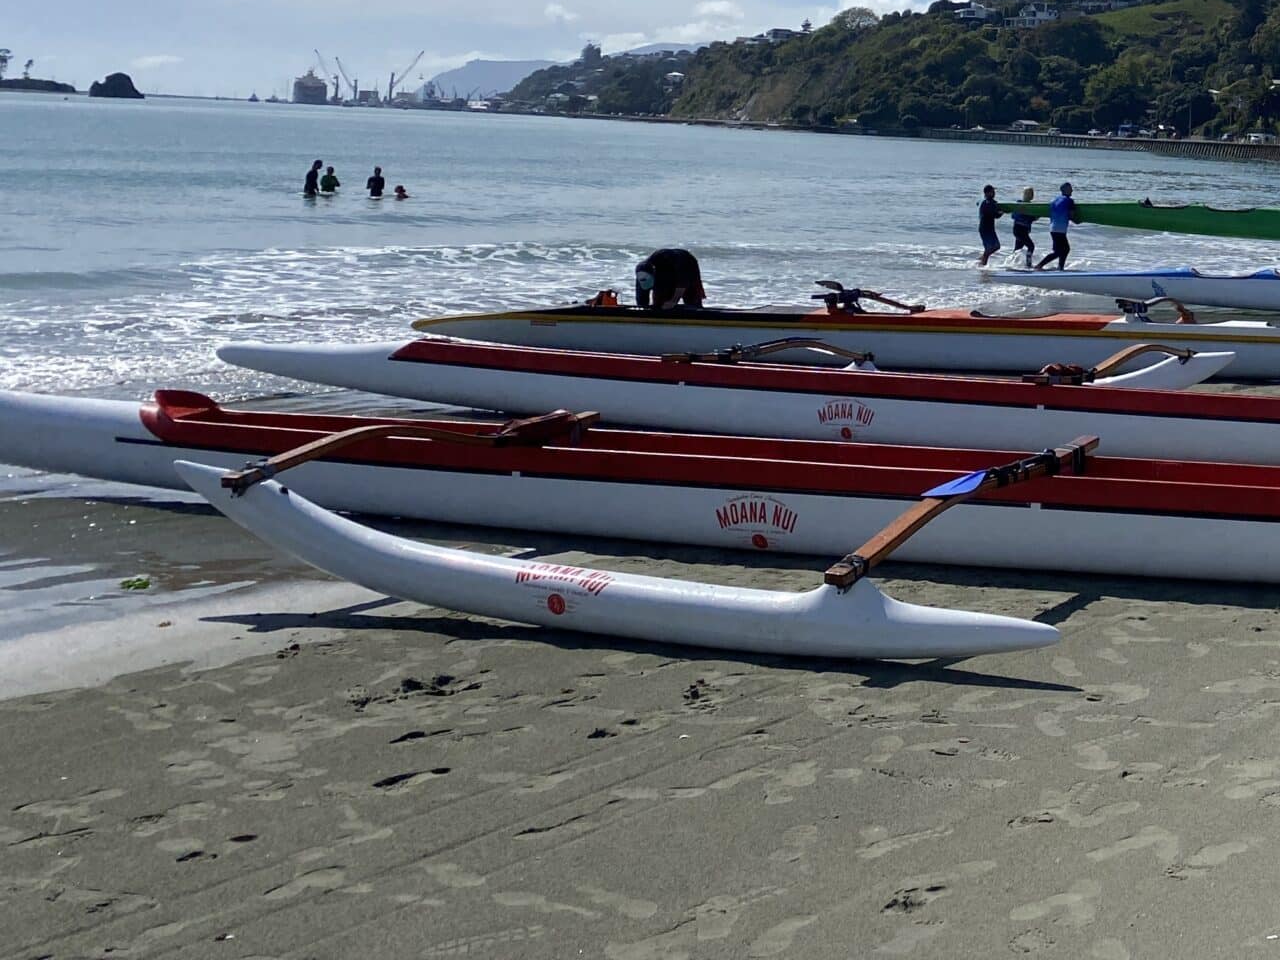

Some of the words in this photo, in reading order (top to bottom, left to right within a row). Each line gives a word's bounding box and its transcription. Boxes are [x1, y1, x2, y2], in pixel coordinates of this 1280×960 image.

[817, 403, 853, 425] MOANA
[856, 405, 875, 426] NUI
[716, 501, 767, 529] MOANA
[772, 504, 798, 533] NUI
